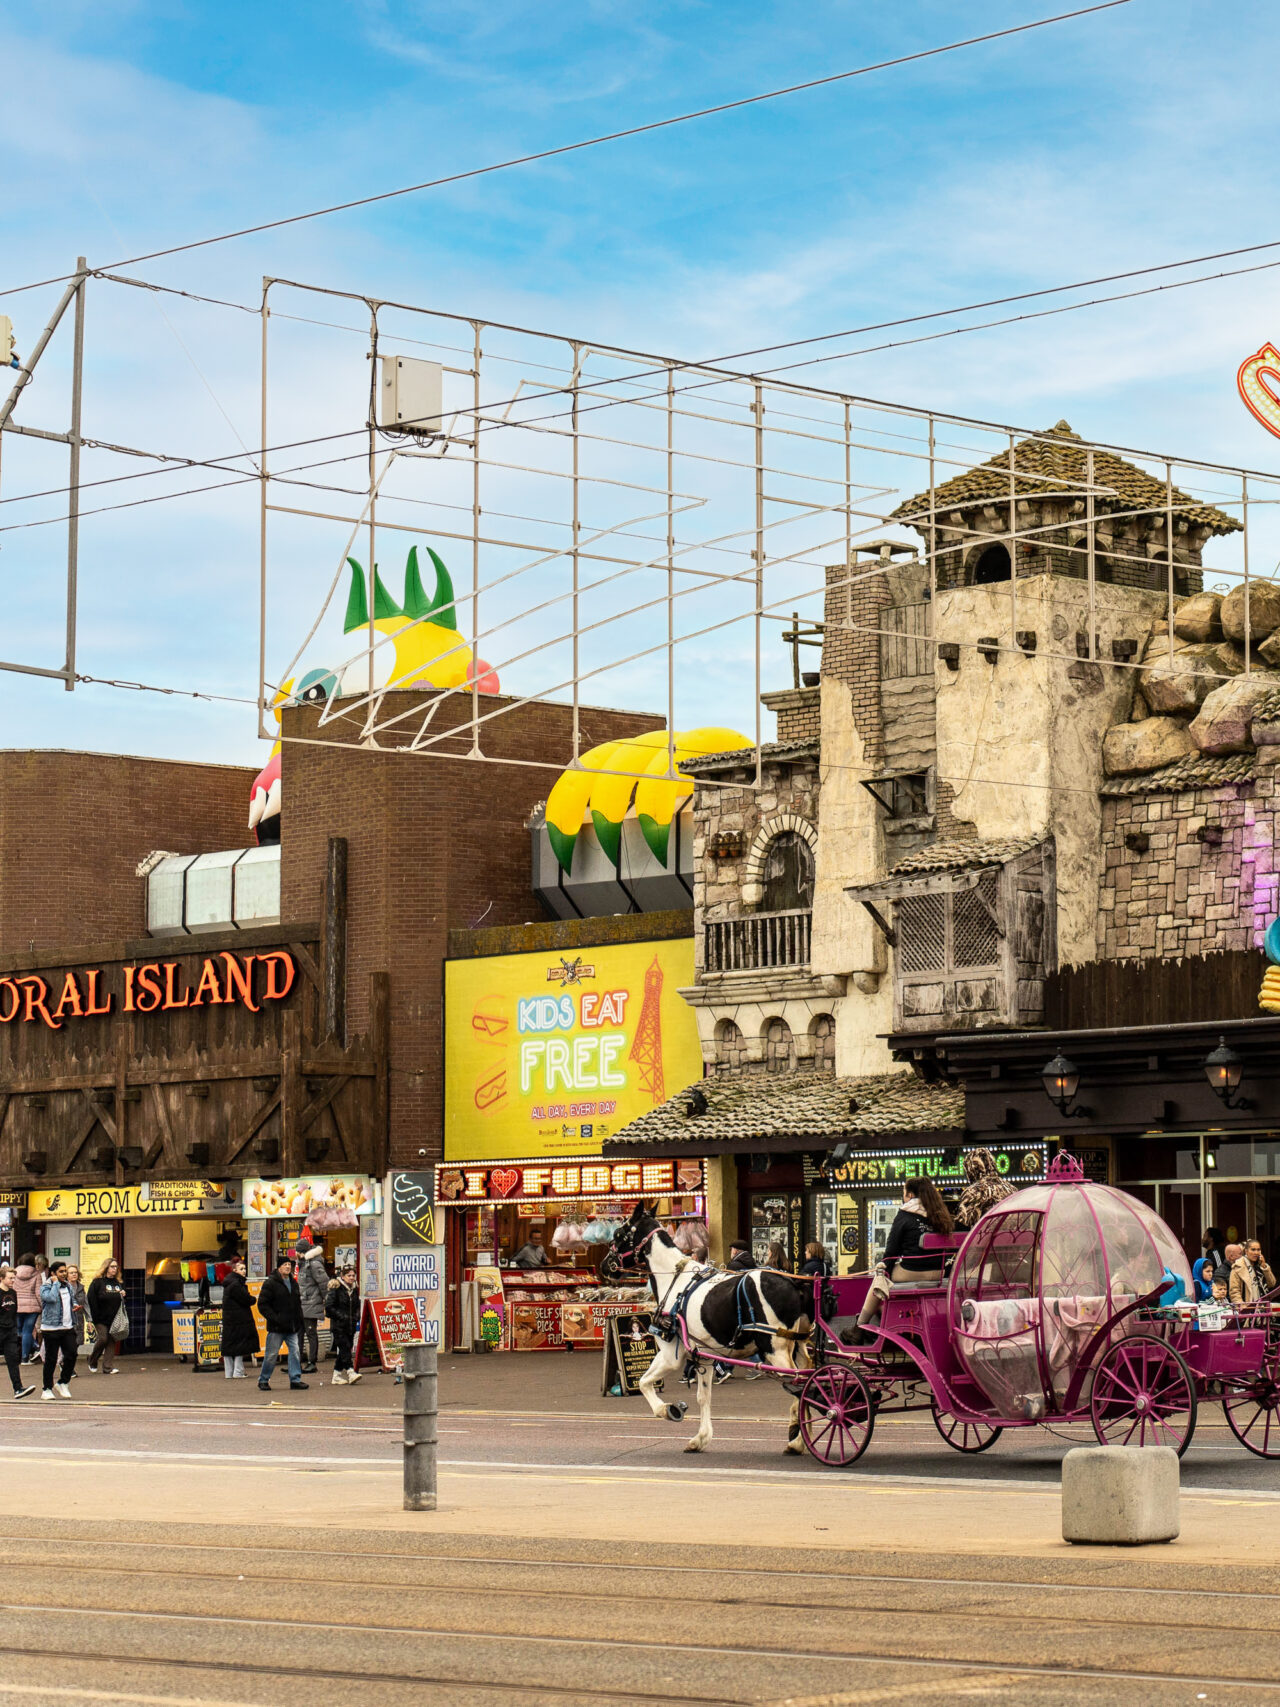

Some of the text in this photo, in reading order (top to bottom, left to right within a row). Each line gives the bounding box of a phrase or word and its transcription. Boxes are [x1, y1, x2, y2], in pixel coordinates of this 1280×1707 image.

[123, 951, 296, 1012] ISLAND
[519, 991, 628, 1032] KIDS EAT
[520, 1034, 626, 1092] FREE
[531, 1100, 616, 1119] ALL DAY, EVERY DAY
[834, 1159, 888, 1182] GYPSY
[894, 1154, 1010, 1178] PETULEO
[150, 1181, 198, 1189] TRADITIONAL
[464, 1163, 675, 1197] I FUDGE
[174, 1189, 195, 1197] CHIPS
[75, 1190, 131, 1215] PROM
[393, 1255, 435, 1272] AWARD
[389, 1273, 438, 1291] WINNING
[379, 1315, 394, 1324] PICK
[402, 1313, 415, 1322] MIX
[535, 1308, 553, 1319] SELF
[592, 1306, 632, 1317] SELF SERVICE
[381, 1324, 398, 1333] HAND
[399, 1322, 418, 1331] MADE
[537, 1320, 554, 1332] PICK
[391, 1332, 413, 1342] FUDGE
[630, 1341, 647, 1351] STOP
